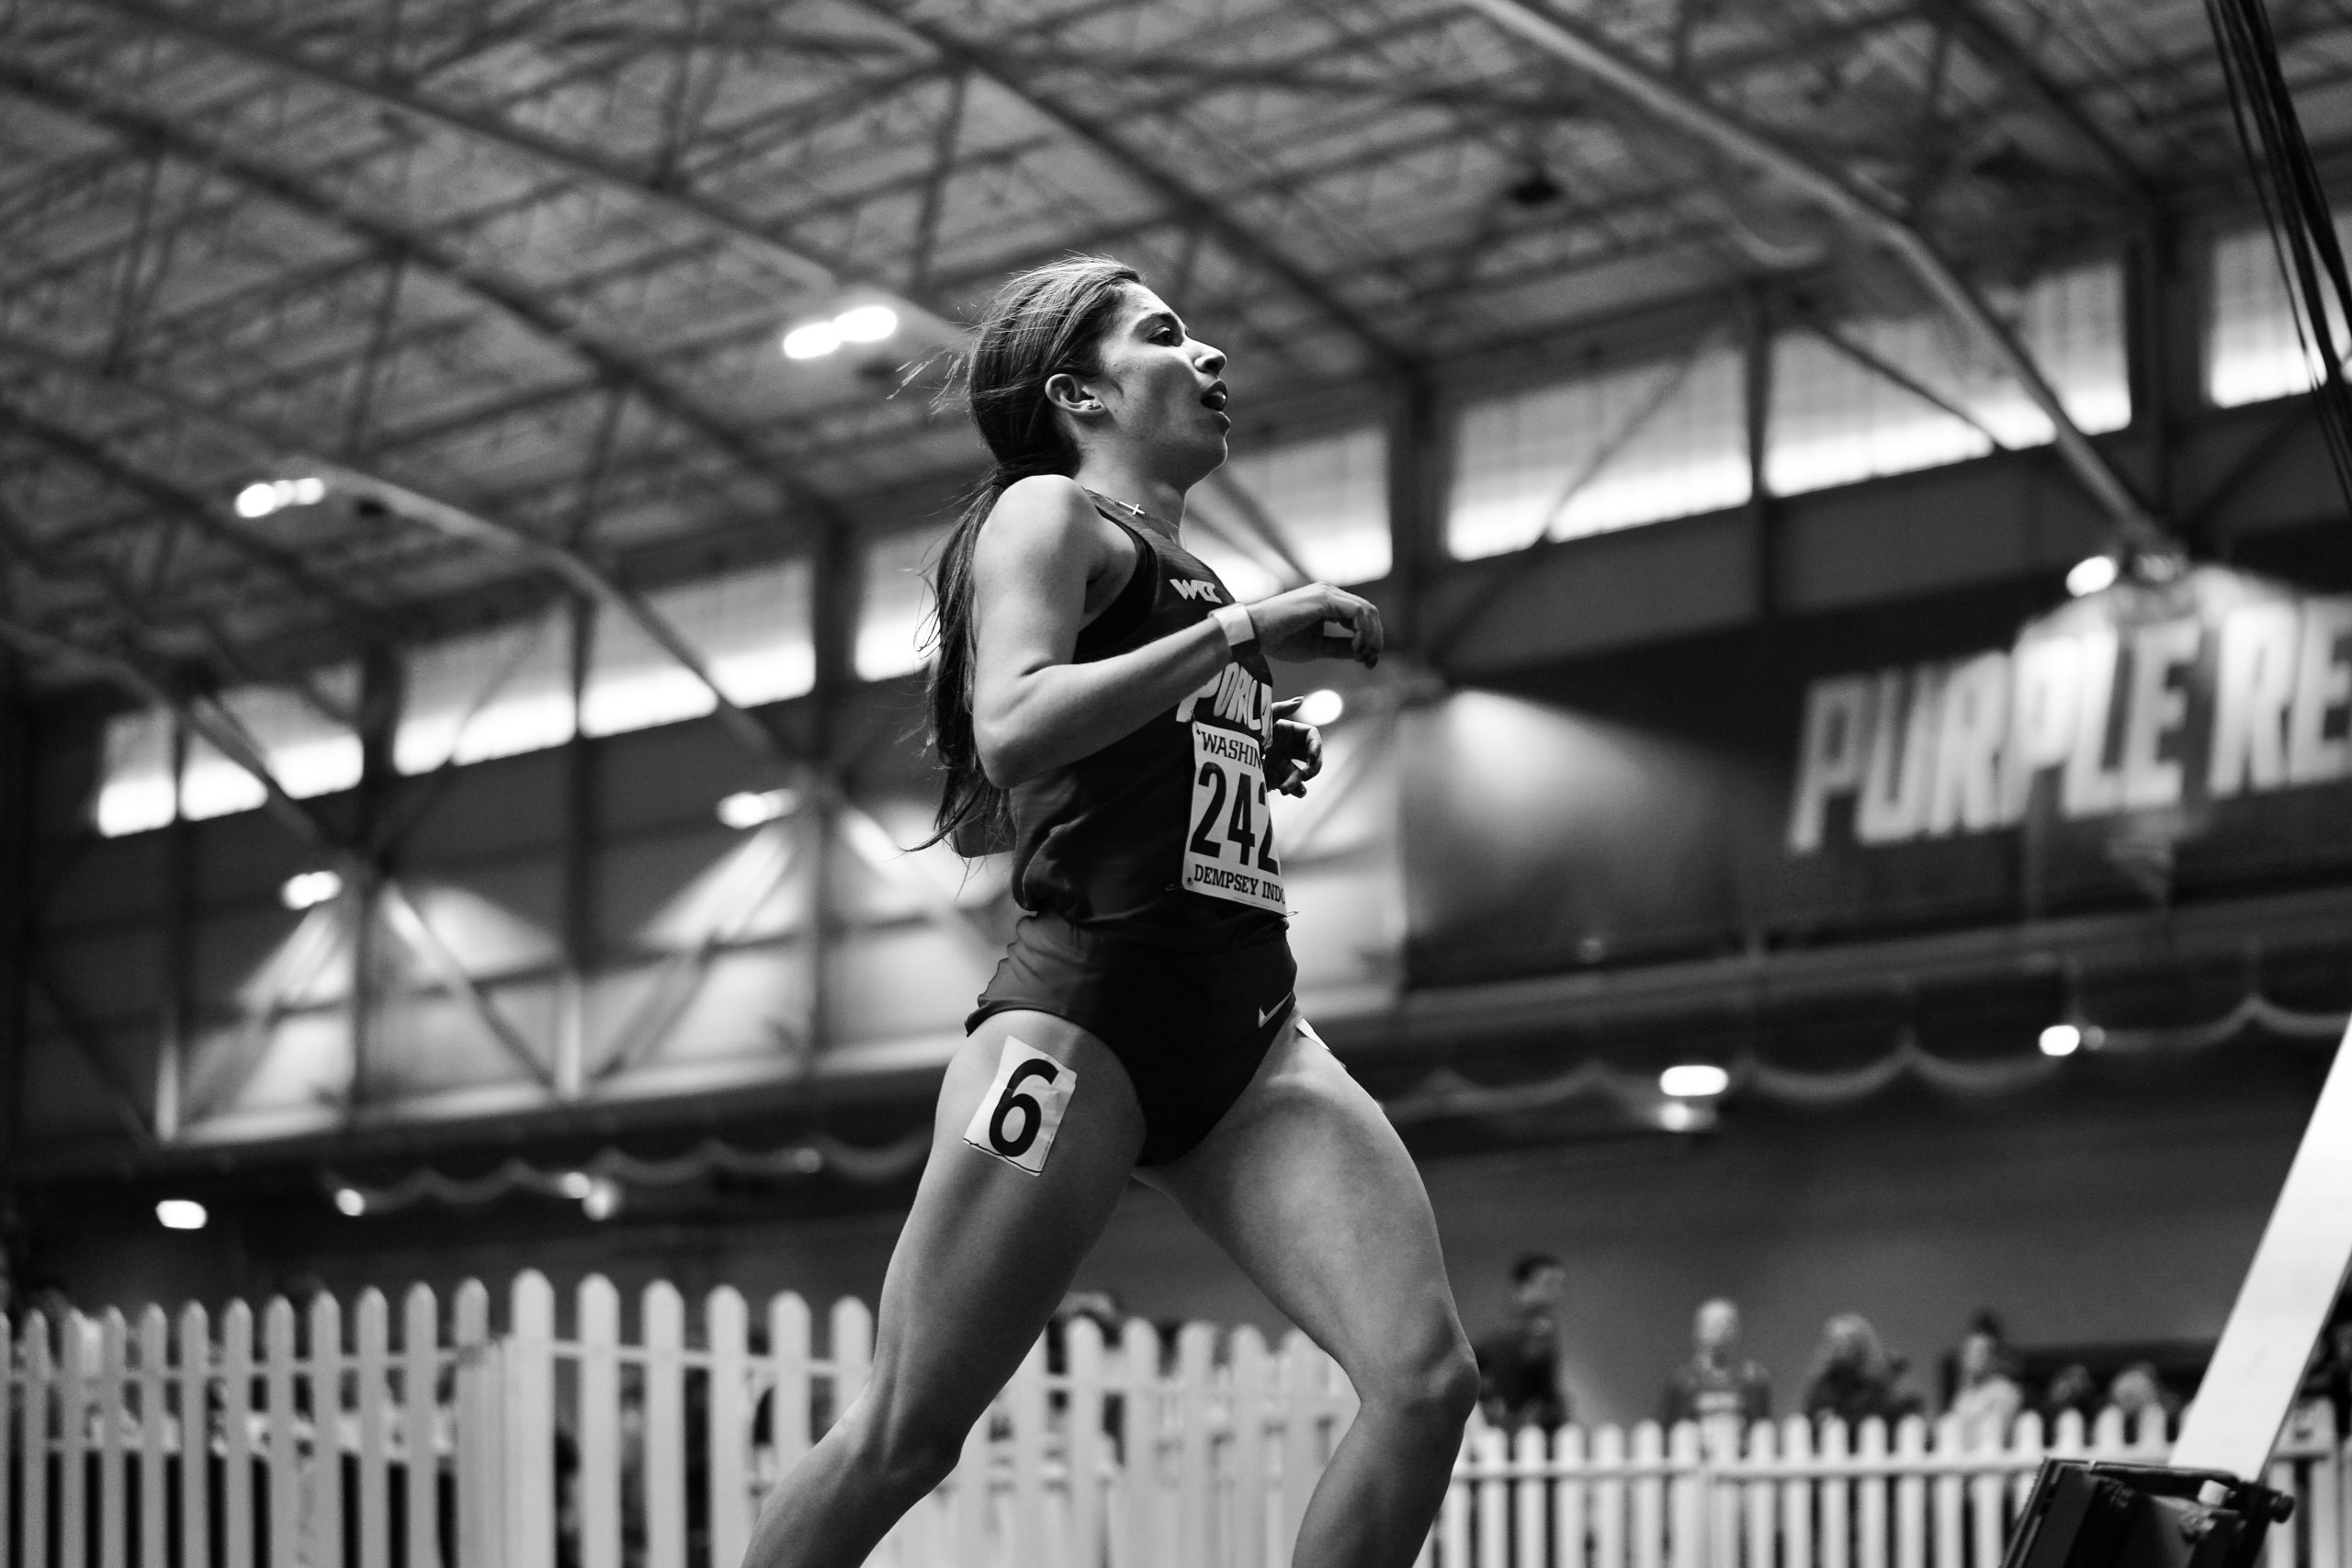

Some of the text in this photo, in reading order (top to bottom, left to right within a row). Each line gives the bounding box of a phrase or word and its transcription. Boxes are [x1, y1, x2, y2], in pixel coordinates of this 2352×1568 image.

[1789, 597, 2352, 854] PURPLE RE
[1190, 761, 1279, 876] 242
[1194, 863, 1259, 896] DEMPSEY
[989, 1058, 1059, 1157] 6
